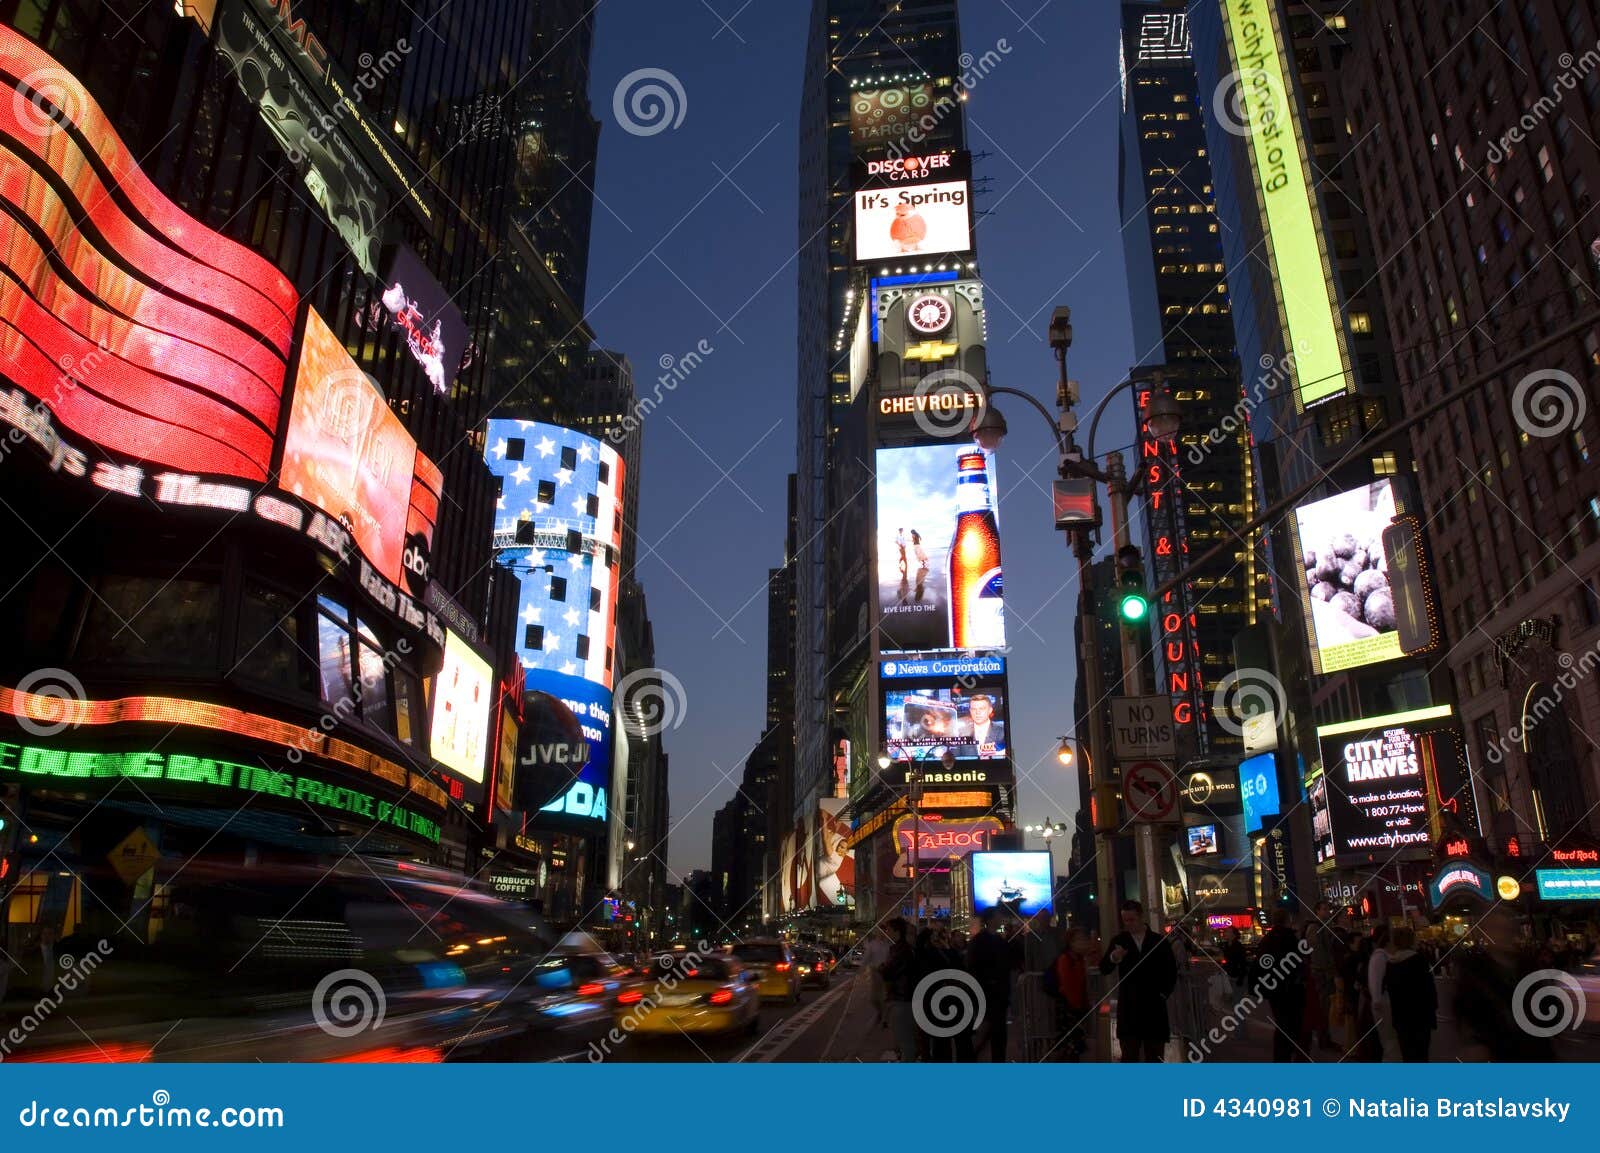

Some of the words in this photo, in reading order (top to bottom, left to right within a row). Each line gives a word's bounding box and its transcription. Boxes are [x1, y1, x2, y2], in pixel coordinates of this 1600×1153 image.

[867, 153, 952, 175] DISCOVER
[889, 169, 930, 181] CARD
[861, 193, 890, 210] It's
[898, 187, 965, 207] Spring
[880, 392, 984, 415] CHEVROLET
[900, 603, 913, 613] LIFE
[923, 602, 937, 612] THE
[897, 659, 930, 675] News
[931, 657, 1002, 676] Corporation
[589, 701, 611, 728] thing
[1128, 705, 1155, 722] NO
[1118, 724, 1171, 745] TURNS
[520, 742, 569, 766] JVC
[1343, 738, 1385, 763] CITY
[904, 769, 988, 784] Pnasonic
[1348, 795, 1359, 805] To
[1358, 793, 1380, 803] make
[1371, 806, 1389, 817] 800
[1347, 830, 1429, 848] www.cityharve
[1552, 850, 1576, 861] Hard
[1576, 850, 1599, 862] Rock
[494, 883, 527, 894] COFFEE
